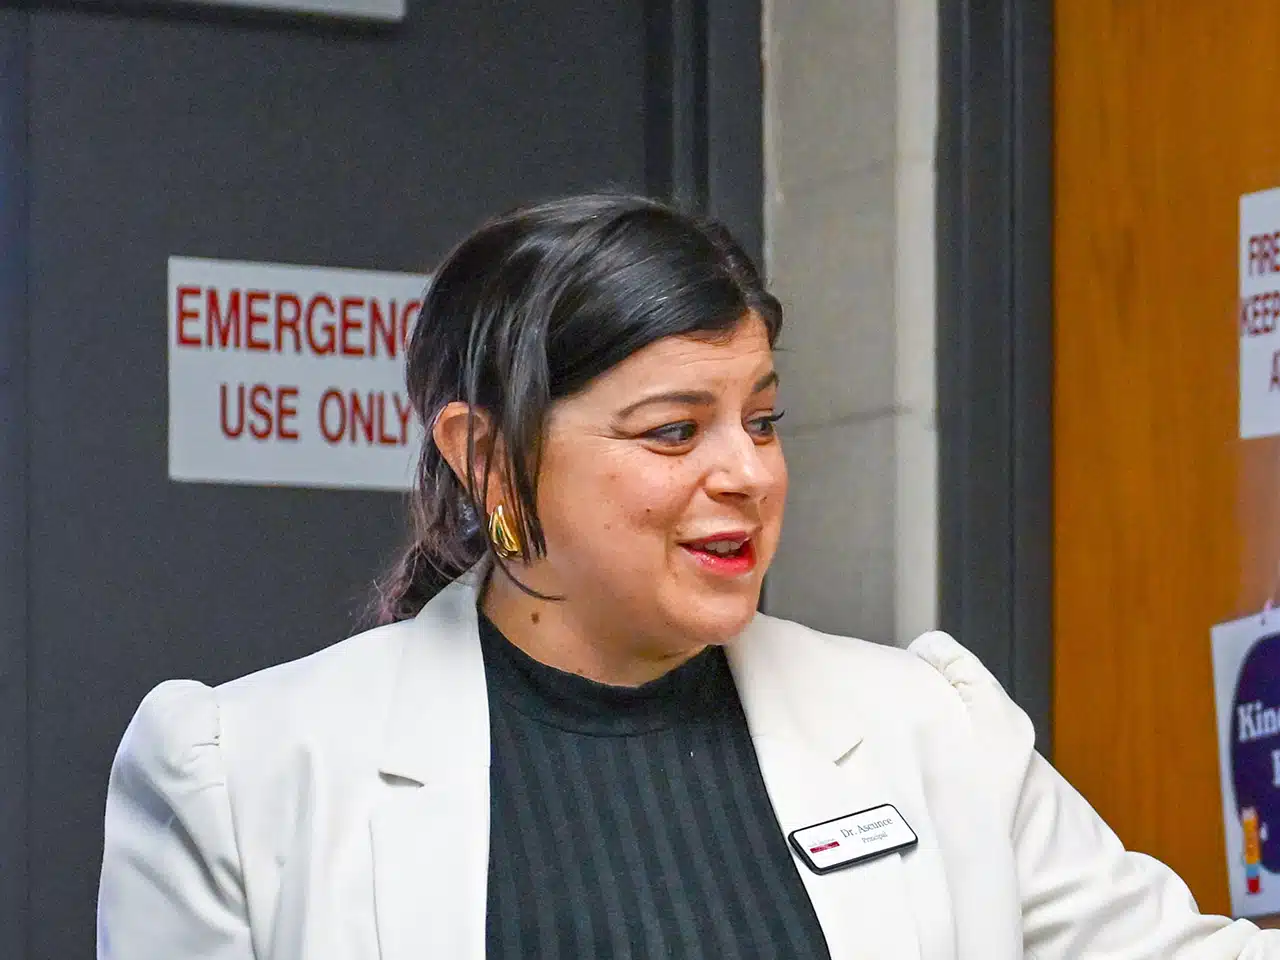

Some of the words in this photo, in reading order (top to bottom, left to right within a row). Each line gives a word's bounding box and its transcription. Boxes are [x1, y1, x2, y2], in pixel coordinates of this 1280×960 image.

[1248, 230, 1280, 276] FIRE
[220, 382, 299, 440] USE
[319, 387, 412, 446] ONLY
[840, 828, 857, 838] Dr.
[858, 817, 893, 833] Ascunce
